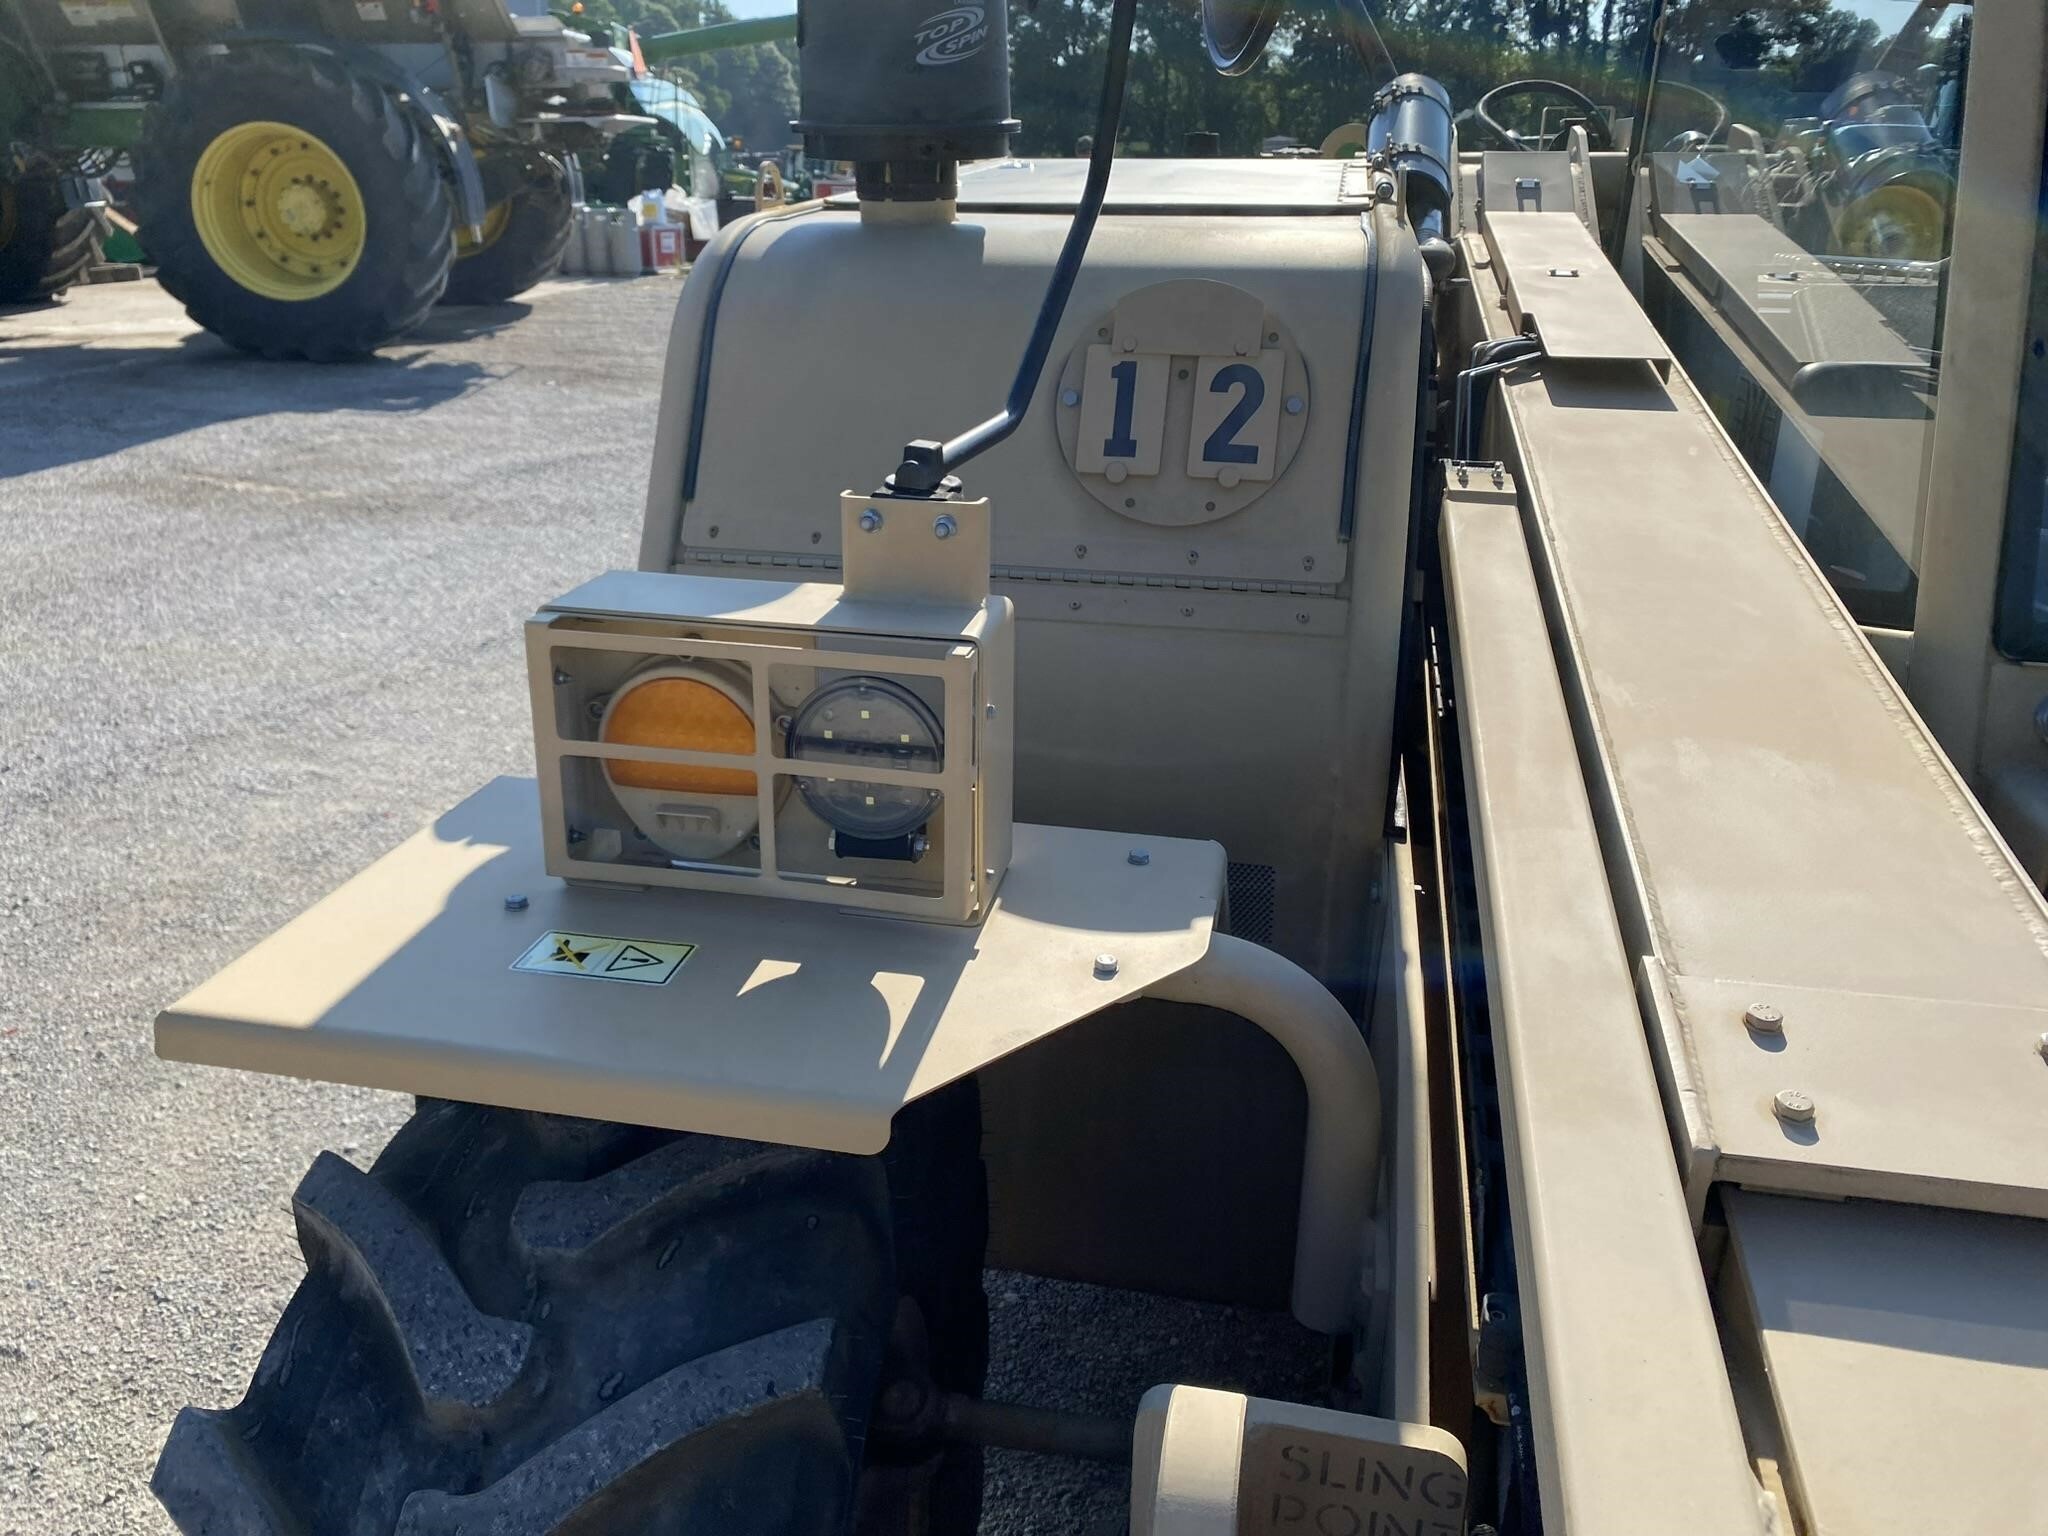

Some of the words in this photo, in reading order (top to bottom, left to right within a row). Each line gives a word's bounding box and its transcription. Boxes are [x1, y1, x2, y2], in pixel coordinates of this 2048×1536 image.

[914, 18, 964, 45] TOP
[944, 25, 988, 54] SPIN
[1280, 1445, 1462, 1508] SLING
